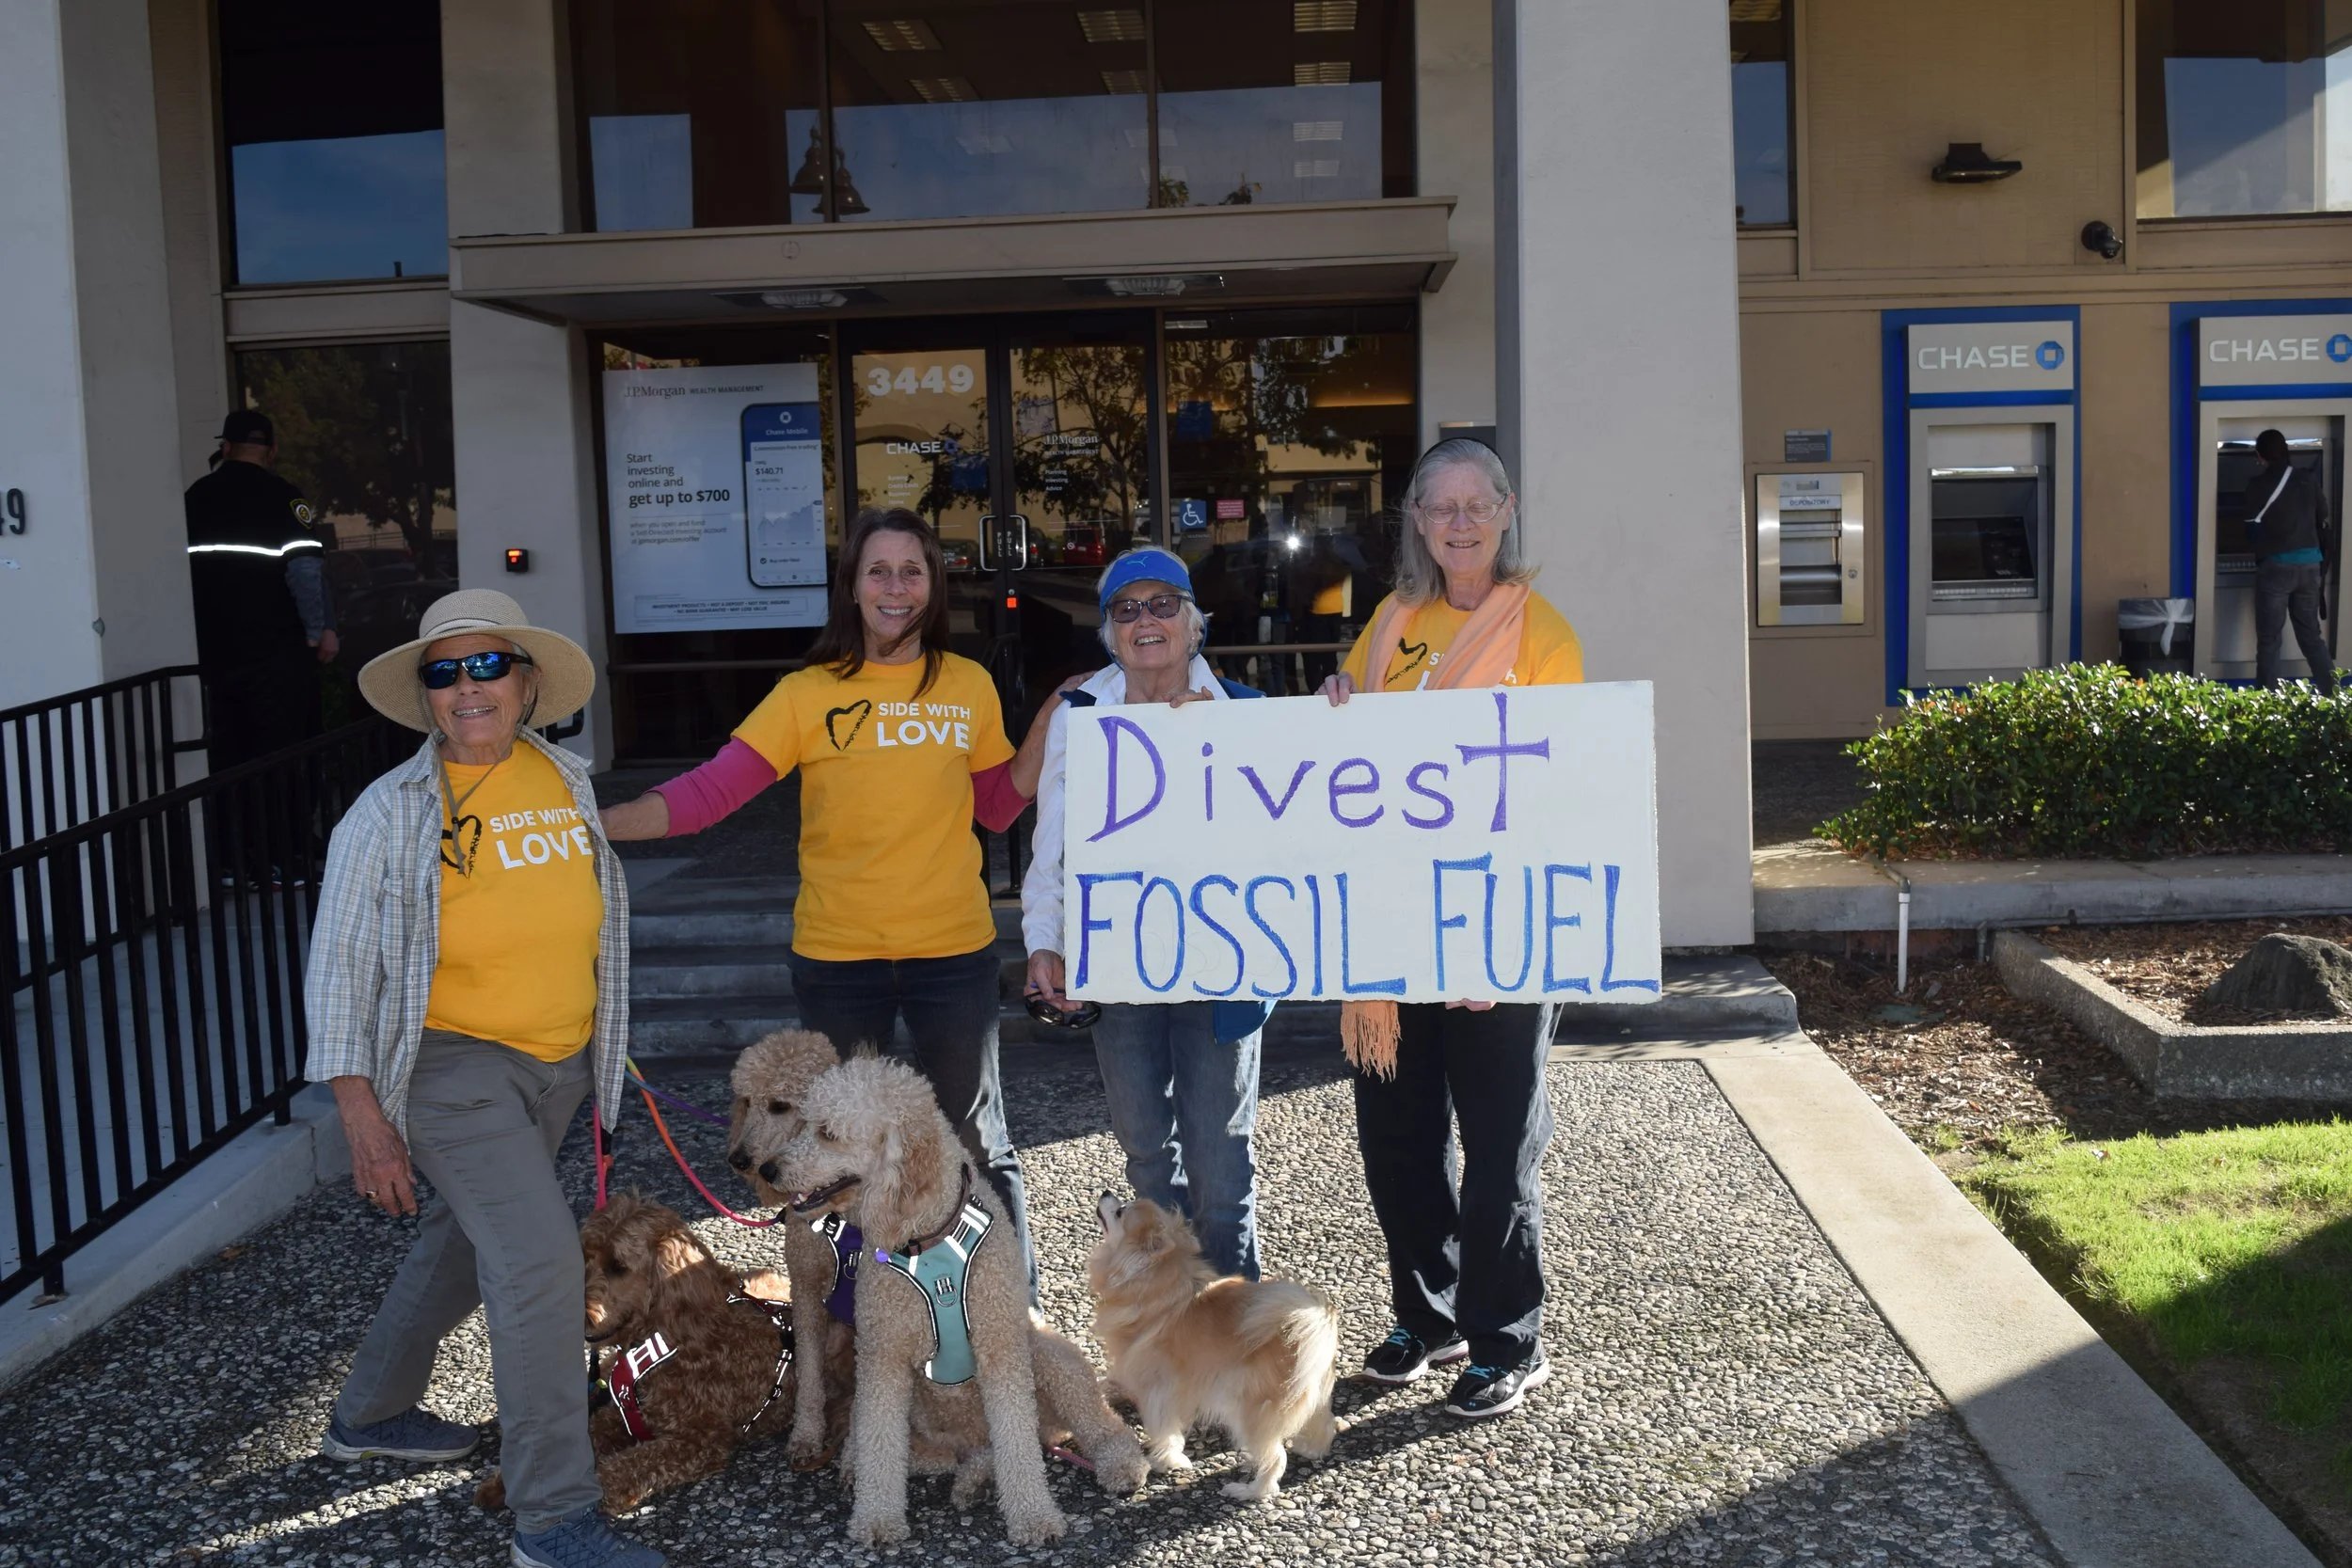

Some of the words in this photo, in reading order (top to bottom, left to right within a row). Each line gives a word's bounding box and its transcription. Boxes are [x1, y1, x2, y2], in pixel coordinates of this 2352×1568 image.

[1917, 345, 2030, 370] CHASE
[2209, 338, 2319, 362] CHASE
[867, 364, 975, 396] 3449
[627, 453, 653, 464] Start
[886, 441, 942, 455] CHASE
[627, 465, 675, 477] investing
[628, 478, 660, 488] online
[663, 476, 684, 487] and
[755, 467, 784, 475] $140.71
[628, 493, 653, 509] get
[656, 494, 675, 508] up
[677, 492, 693, 503] to
[695, 489, 731, 503] $700
[0, 488, 25, 535] 9
[878, 703, 920, 717] SIDE
[926, 704, 970, 721] WITH
[877, 721, 970, 750] LOVE
[1085, 691, 1551, 843] Divest
[489, 811, 536, 833] SIDE
[537, 808, 580, 825] WITH
[496, 825, 593, 870] LOVE
[1074, 871, 1406, 998] FOSSIL
[1433, 851, 1660, 996] FUEL
